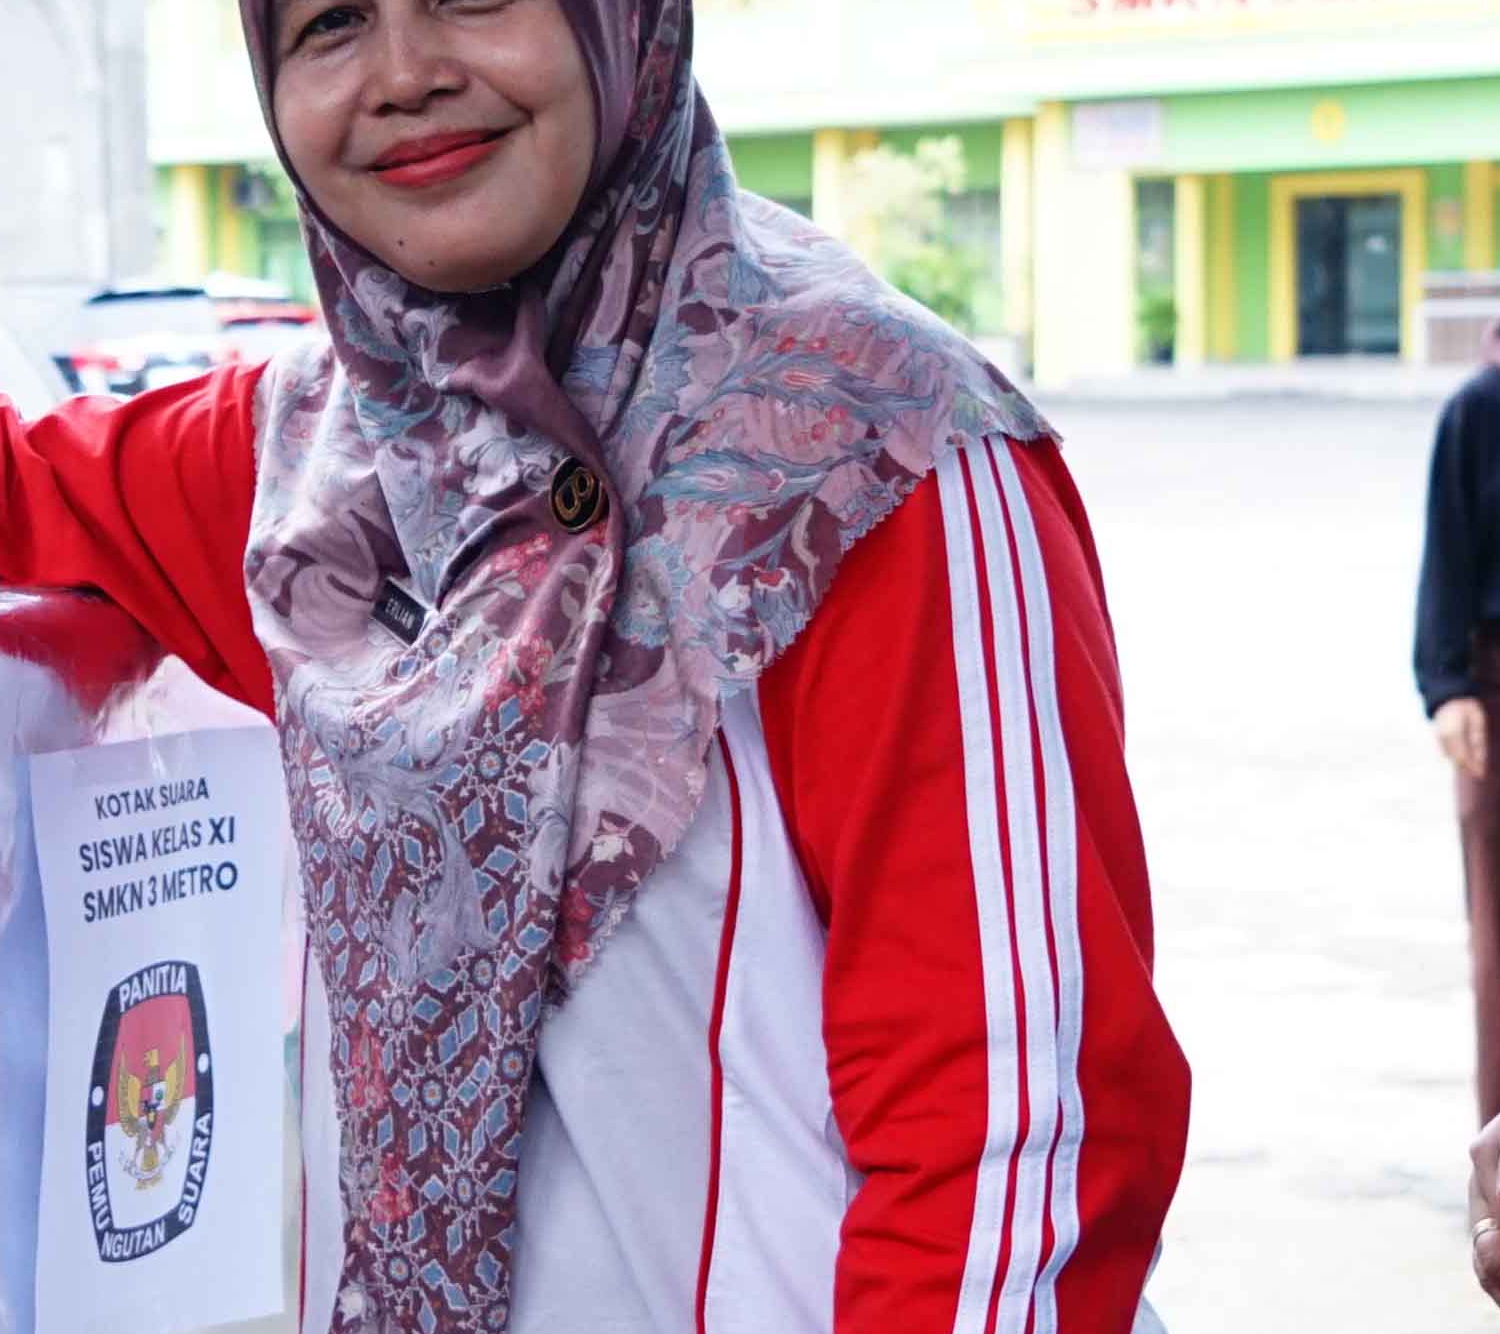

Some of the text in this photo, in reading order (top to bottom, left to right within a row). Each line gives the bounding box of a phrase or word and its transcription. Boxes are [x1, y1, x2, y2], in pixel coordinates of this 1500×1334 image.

[94, 777, 210, 820] KOTAK SUARA
[78, 815, 235, 874] SISWA KELAS XI
[82, 861, 239, 924] SMKN 3 METRO
[118, 964, 188, 1014] PANITIA
[177, 1112, 213, 1224] SUARA
